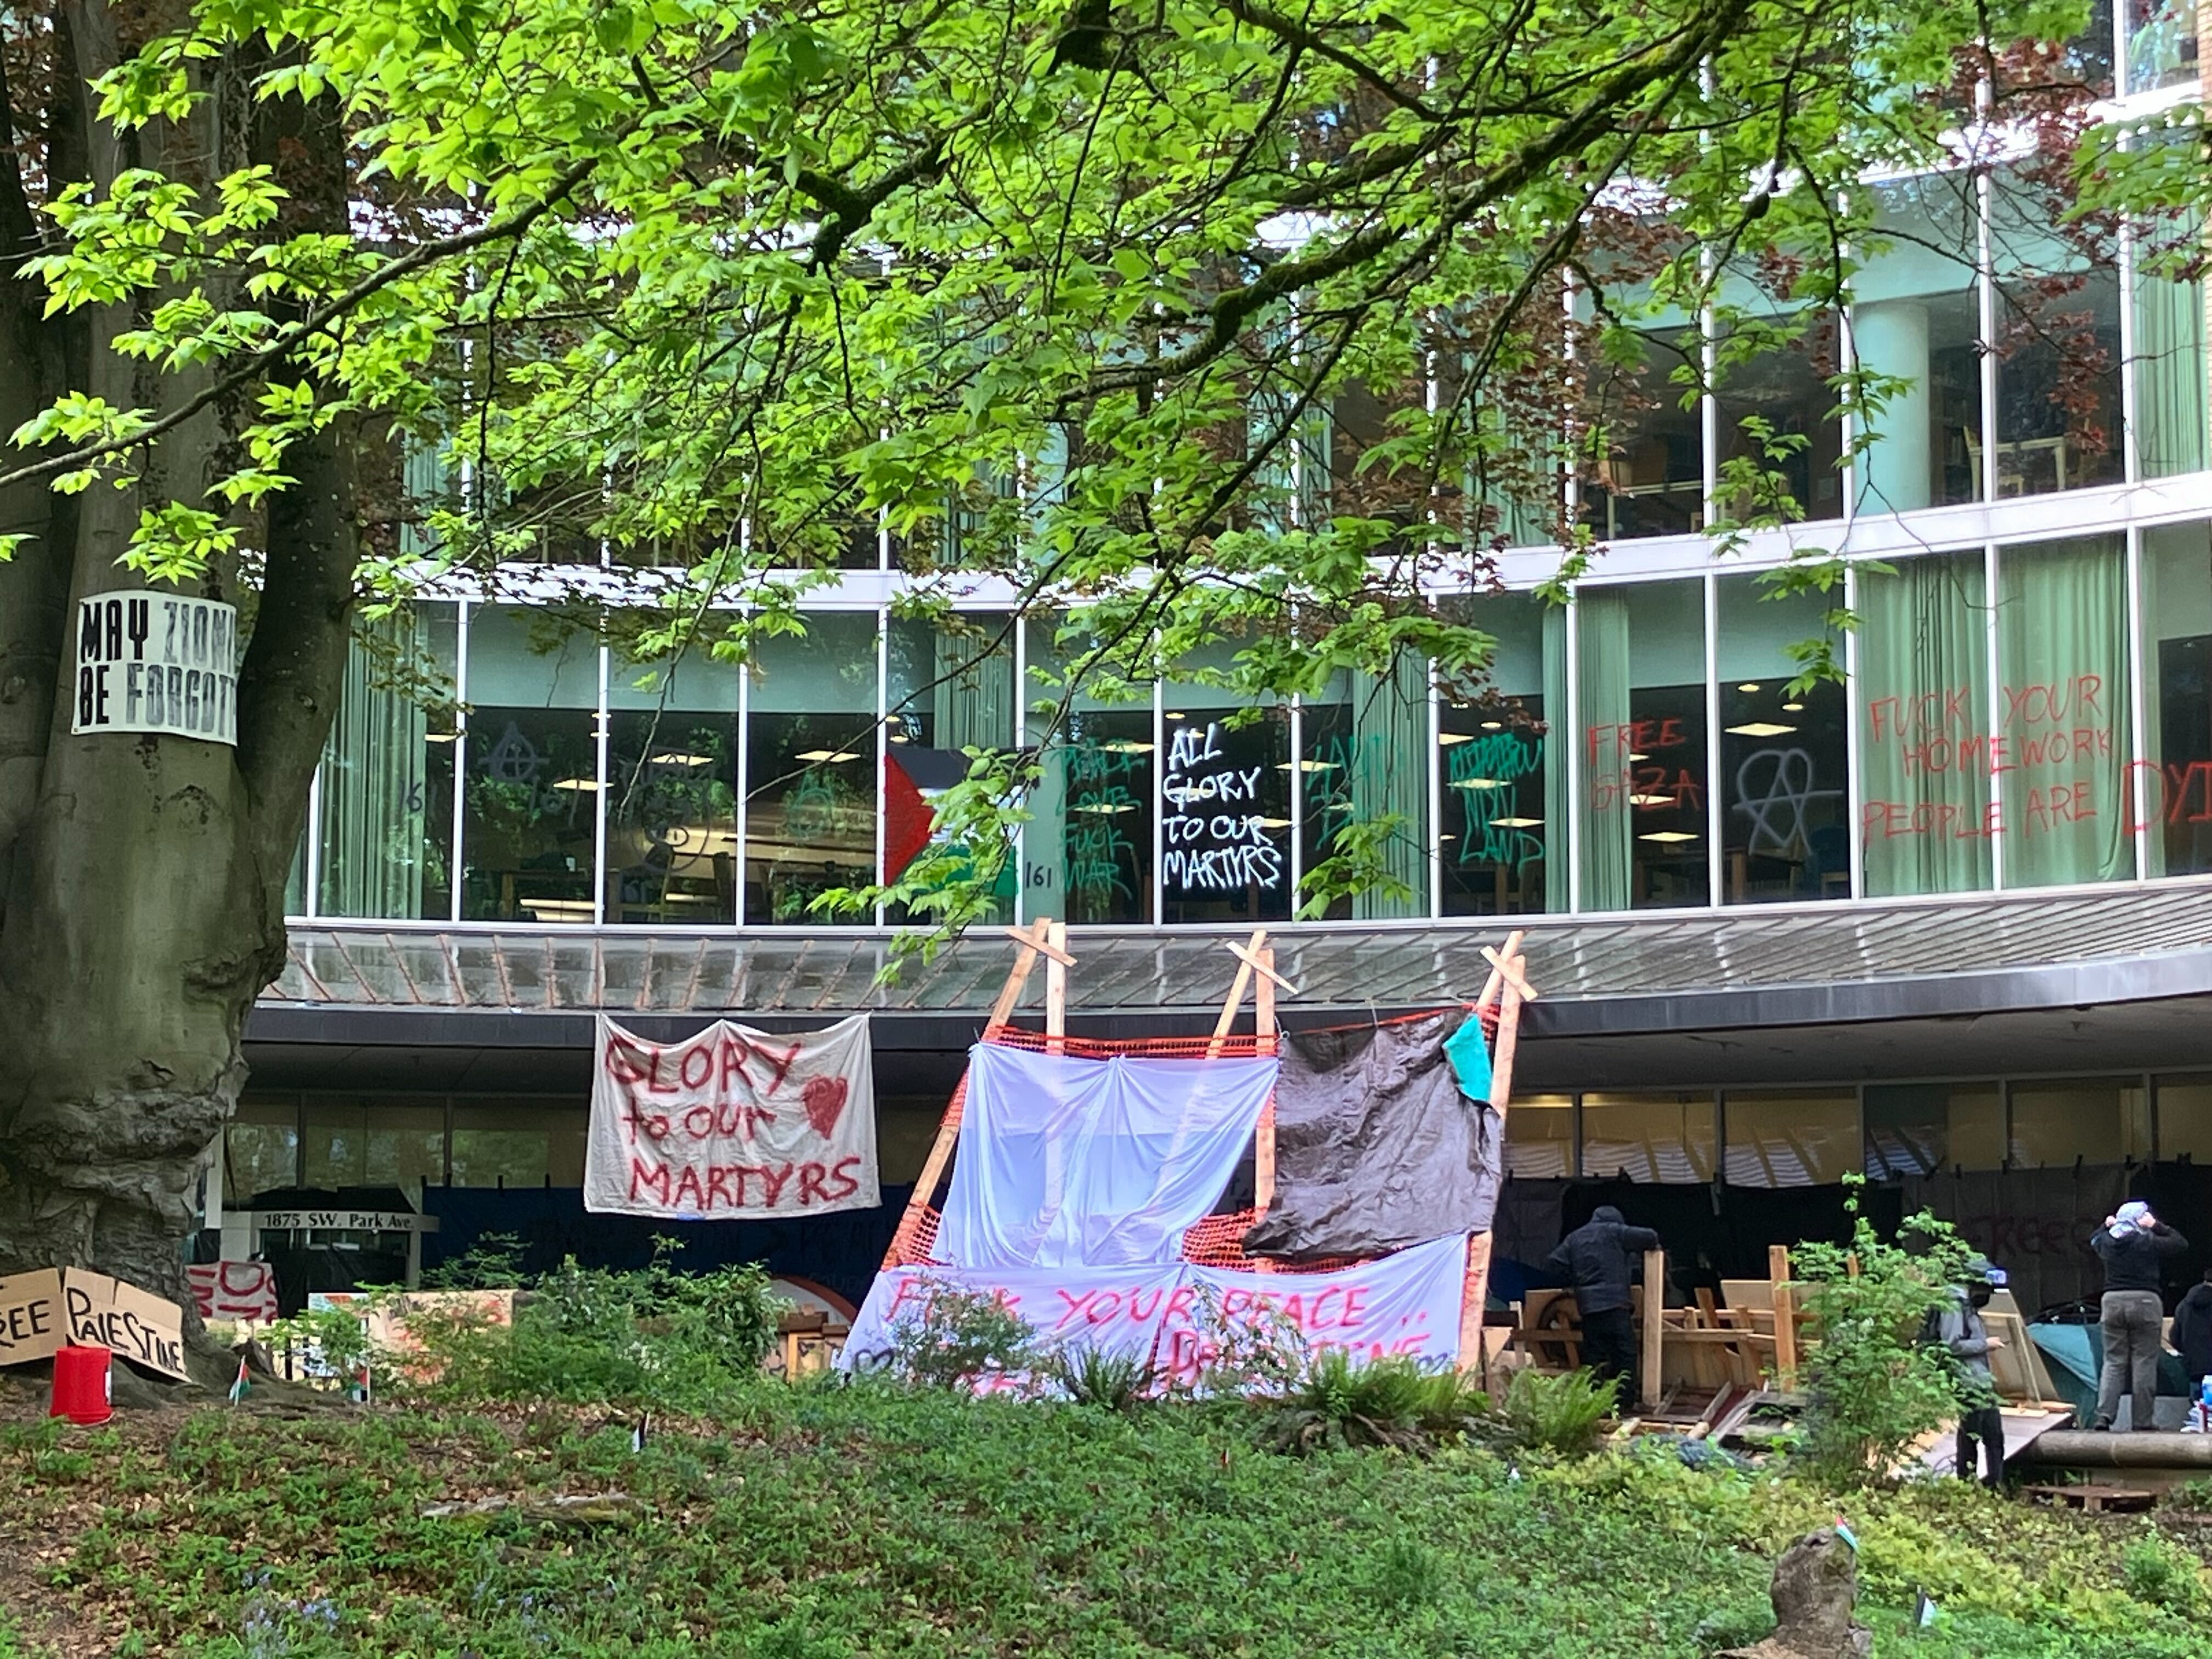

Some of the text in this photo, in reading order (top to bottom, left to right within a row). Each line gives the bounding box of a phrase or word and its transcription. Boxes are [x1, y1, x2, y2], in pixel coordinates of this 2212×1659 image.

[80, 599, 149, 664] MAY
[80, 664, 109, 727] BE
[1869, 675, 2103, 743] FUCK YOUR
[1167, 723, 1223, 770] ALL
[1587, 718, 1688, 767] FREE
[1162, 766, 1262, 811] GLORY
[1592, 767, 1701, 811] GAZA
[1162, 815, 1204, 845] TO
[1210, 814, 1274, 846] OUR
[1863, 801, 2008, 847] PEOPLE
[2024, 781, 2097, 839] ARE
[1025, 861, 1053, 889] 161
[1163, 845, 1282, 889] MARTYRS
[606, 1033, 802, 1096] GLORY
[629, 1156, 862, 1209] MARTYRS
[264, 1212, 301, 1228] 1875
[349, 1212, 383, 1228] Park
[0, 1299, 50, 1348] REE
[884, 1276, 1023, 1323] FK
[1056, 1285, 1198, 1330] YOUR
